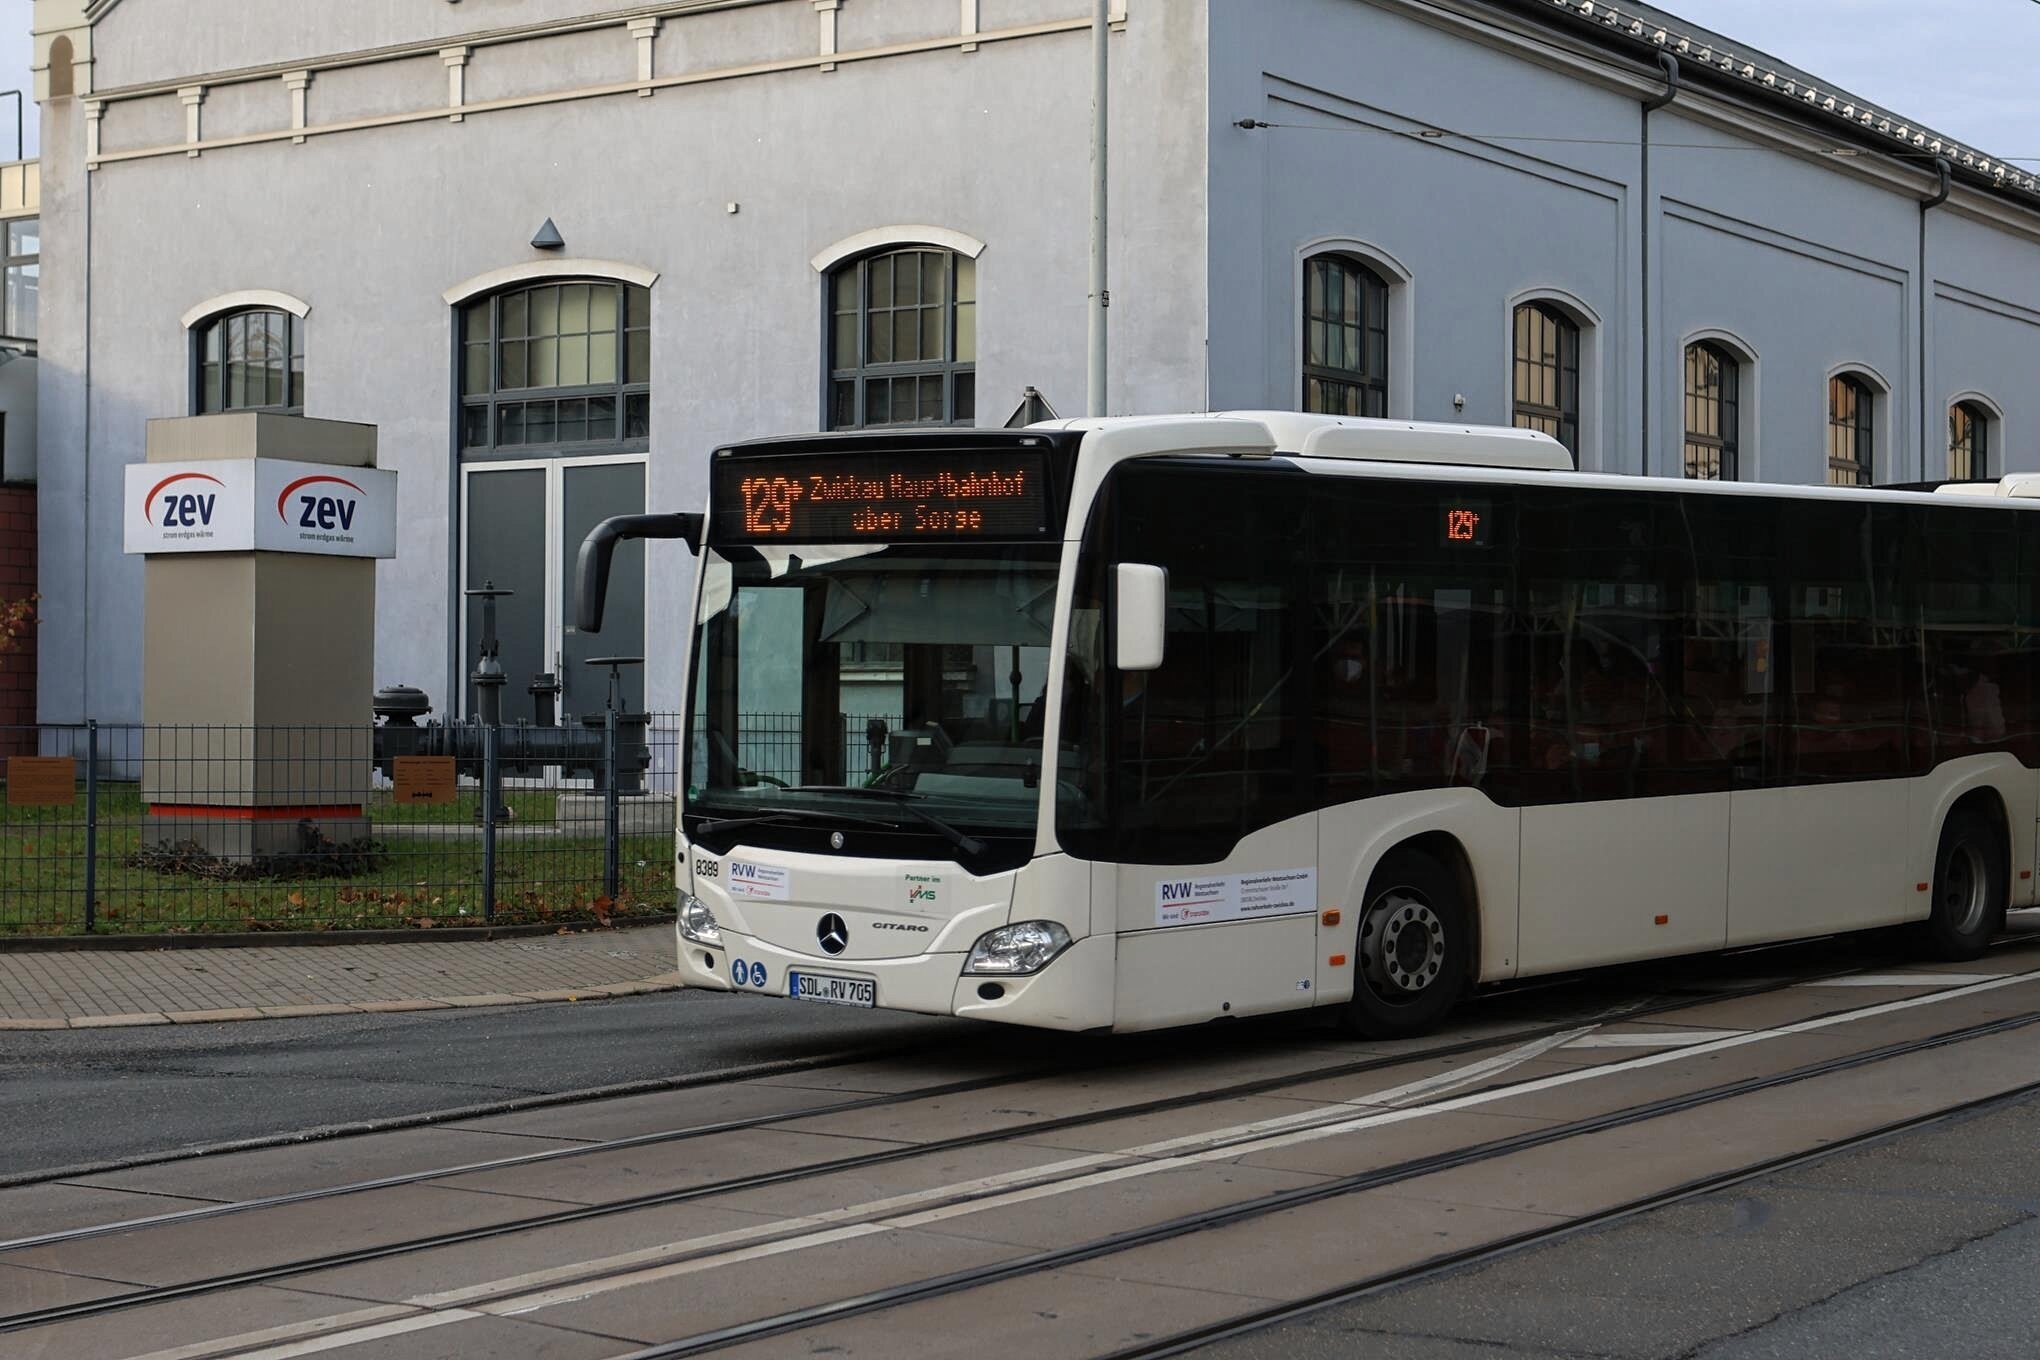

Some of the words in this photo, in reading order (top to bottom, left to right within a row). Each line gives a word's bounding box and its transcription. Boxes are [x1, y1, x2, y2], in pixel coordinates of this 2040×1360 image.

[809, 474, 884, 500] Zwickau
[890, 470, 1024, 498] Hauptbahnhof
[163, 494, 216, 527] zev
[300, 495, 356, 531] zev
[915, 504, 981, 529] Sorge
[696, 859, 719, 877] 8389
[732, 862, 756, 878] RVW
[905, 874, 930, 882] Partner
[1162, 882, 1192, 900] RVW
[800, 977, 822, 996] SDL
[831, 980, 846, 999] RV
[849, 982, 872, 1001] 705
